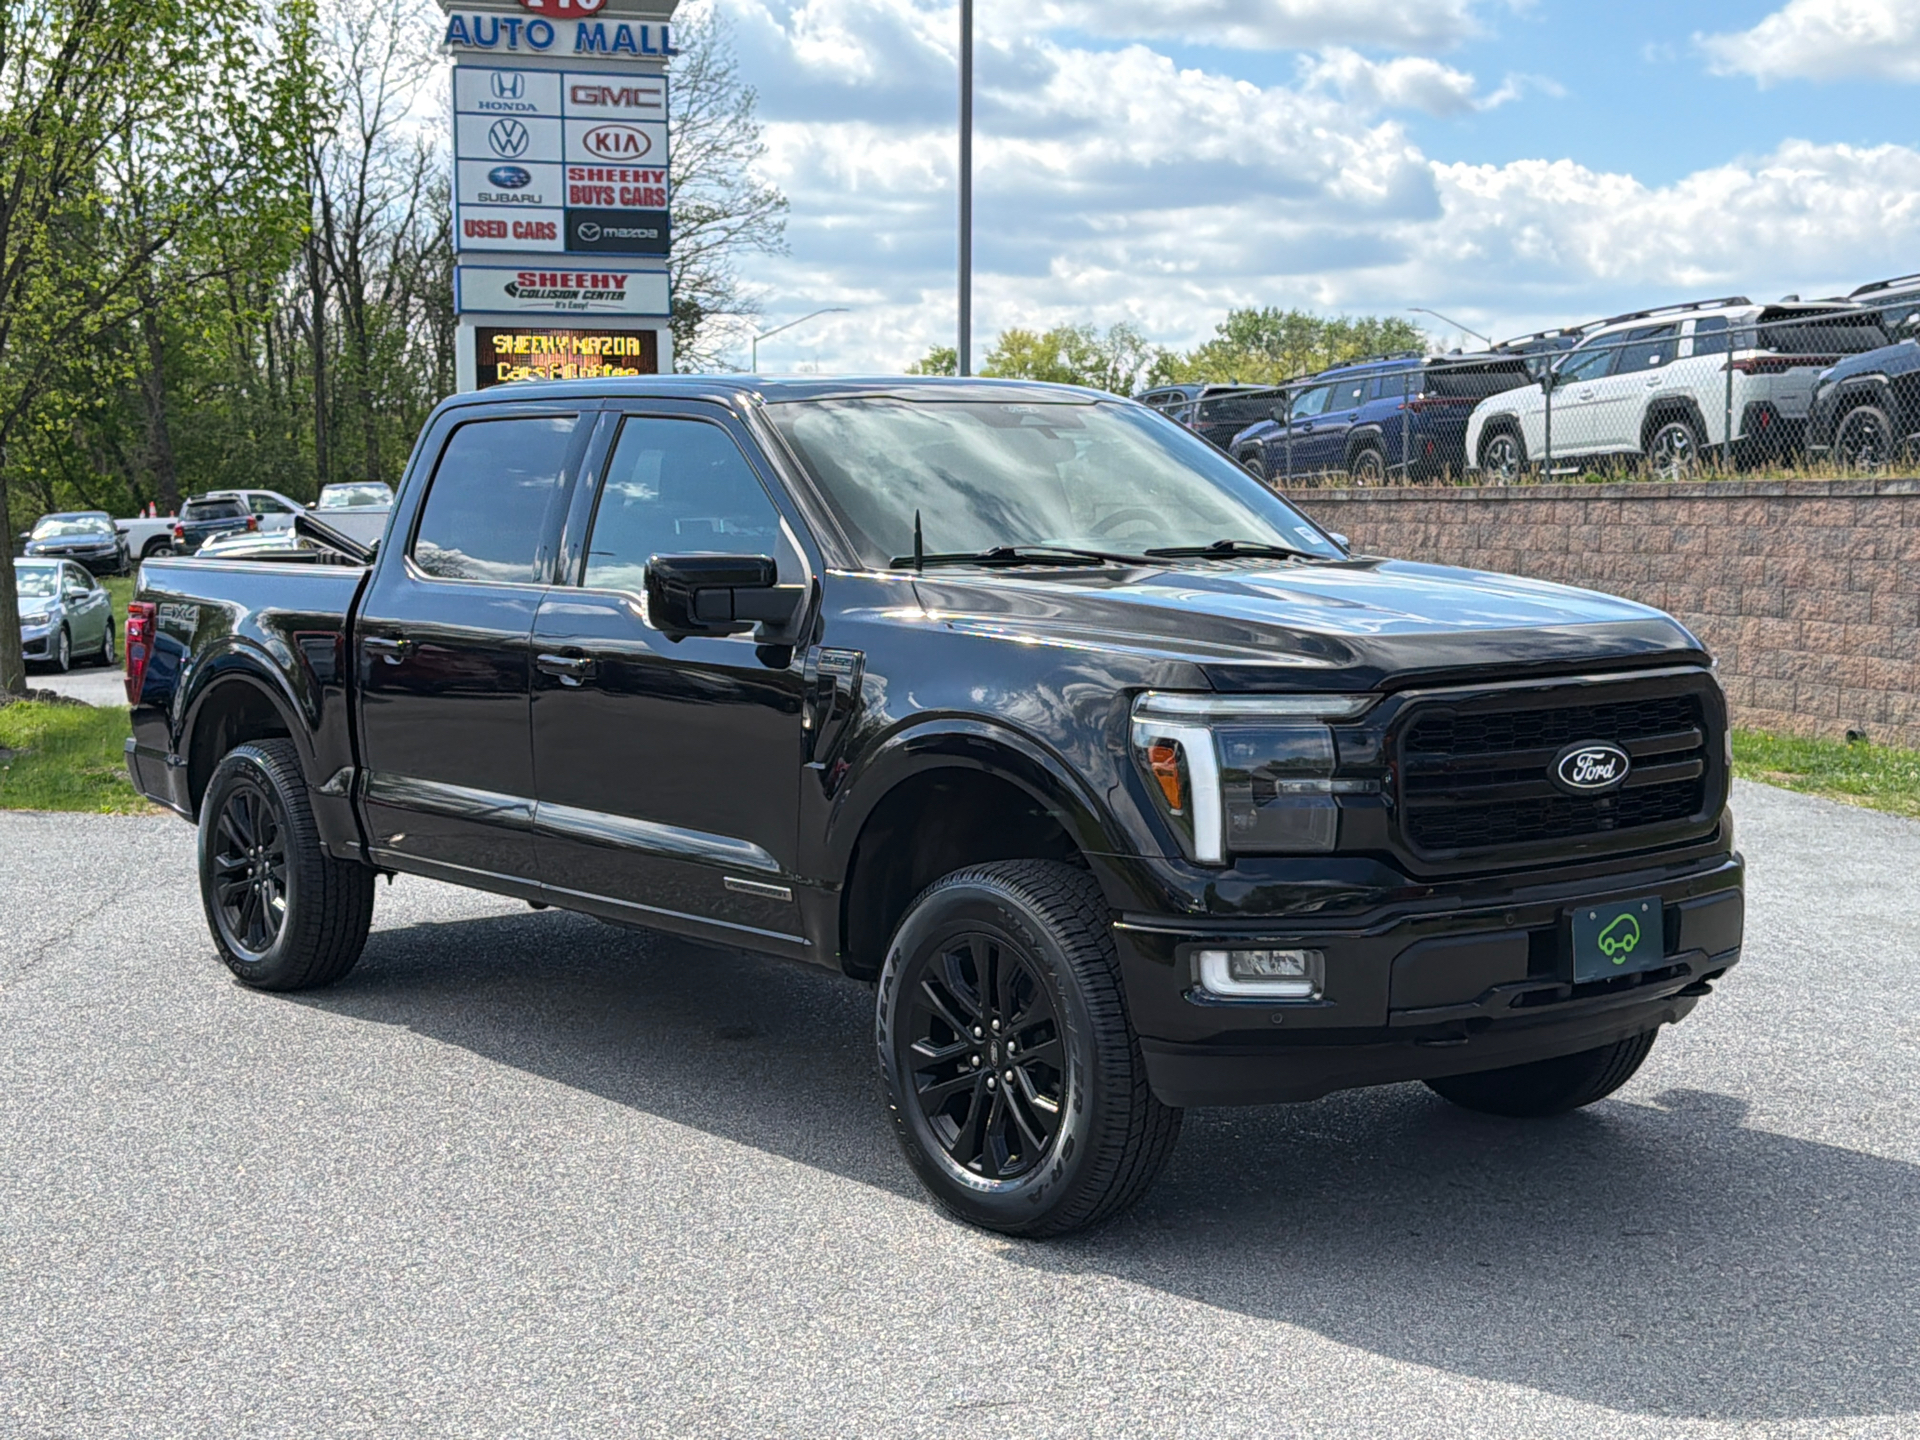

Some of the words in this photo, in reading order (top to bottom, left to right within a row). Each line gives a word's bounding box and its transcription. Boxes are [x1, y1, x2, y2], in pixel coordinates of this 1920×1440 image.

[443, 14, 555, 50] AUTO
[573, 22, 679, 57] MALL
[477, 100, 538, 112] HONDA
[570, 84, 662, 109] GMC
[595, 132, 640, 153] KIA
[568, 167, 666, 184] SHEEHY
[477, 192, 543, 204] SUBARU
[569, 184, 616, 206] BUYS
[619, 186, 666, 207] CARS
[463, 219, 508, 239] USED
[512, 221, 558, 241] CARS
[602, 228, 659, 239] mazda
[517, 272, 628, 289] SHEEHY
[518, 288, 579, 300] COLLISION
[582, 290, 627, 301] CENTER
[492, 334, 570, 355] SHEEHY
[158, 602, 202, 630] FX4
[1572, 752, 1617, 782] Ford
